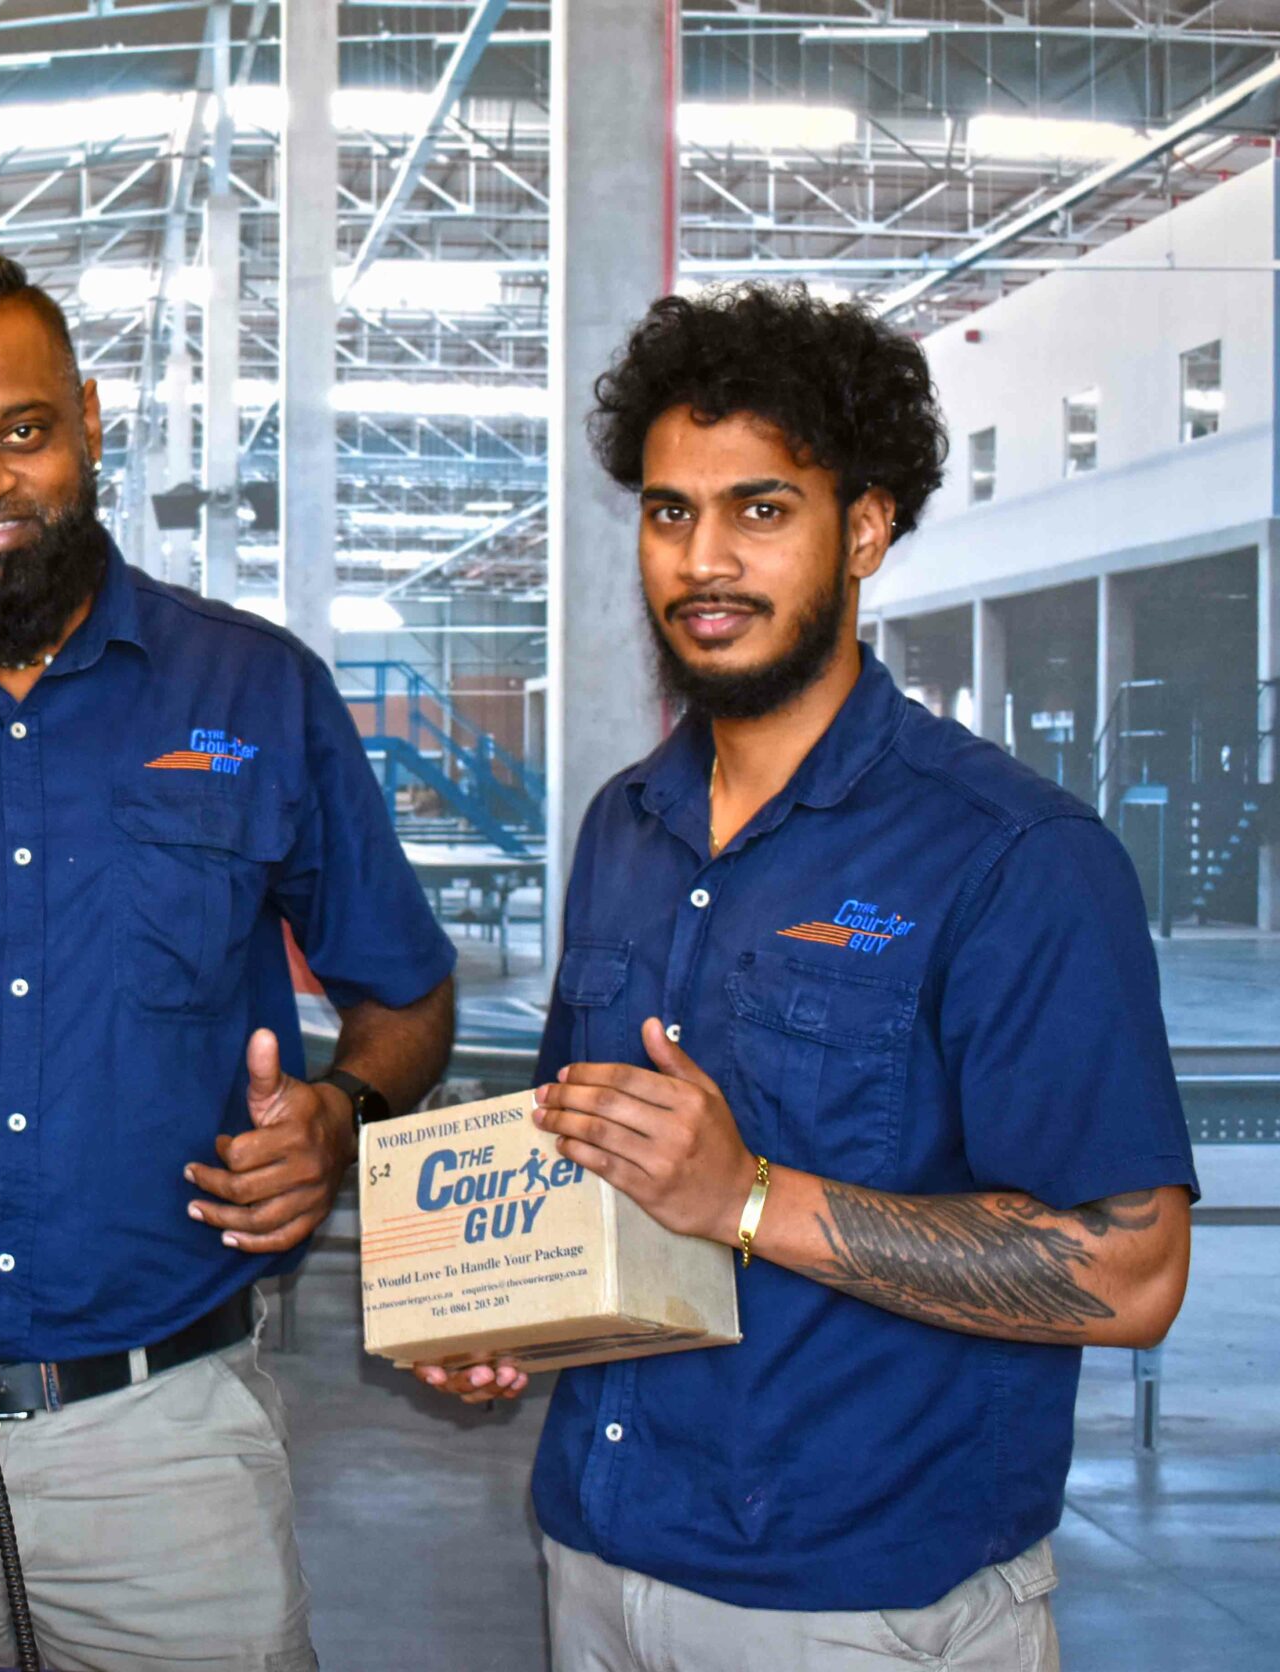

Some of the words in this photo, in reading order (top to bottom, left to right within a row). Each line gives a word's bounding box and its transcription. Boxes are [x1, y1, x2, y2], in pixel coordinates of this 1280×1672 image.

[207, 730, 224, 740] THE
[211, 756, 241, 775] GUY
[857, 903, 880, 914] THE
[849, 933, 890, 955] GUY
[377, 1121, 461, 1150] WORLDWIDE
[464, 1106, 524, 1134] EXPRESS
[459, 1145, 495, 1169] THE
[464, 1195, 546, 1244] GUY
[377, 1273, 412, 1289] Would
[415, 1268, 441, 1283] Love
[444, 1264, 458, 1277] To
[461, 1258, 501, 1275] Handle
[504, 1253, 532, 1266] Your
[535, 1245, 584, 1262] Package
[431, 1305, 448, 1317] Tel:
[450, 1301, 472, 1314] 0861
[475, 1298, 491, 1311] 203
[493, 1295, 510, 1308] 203
